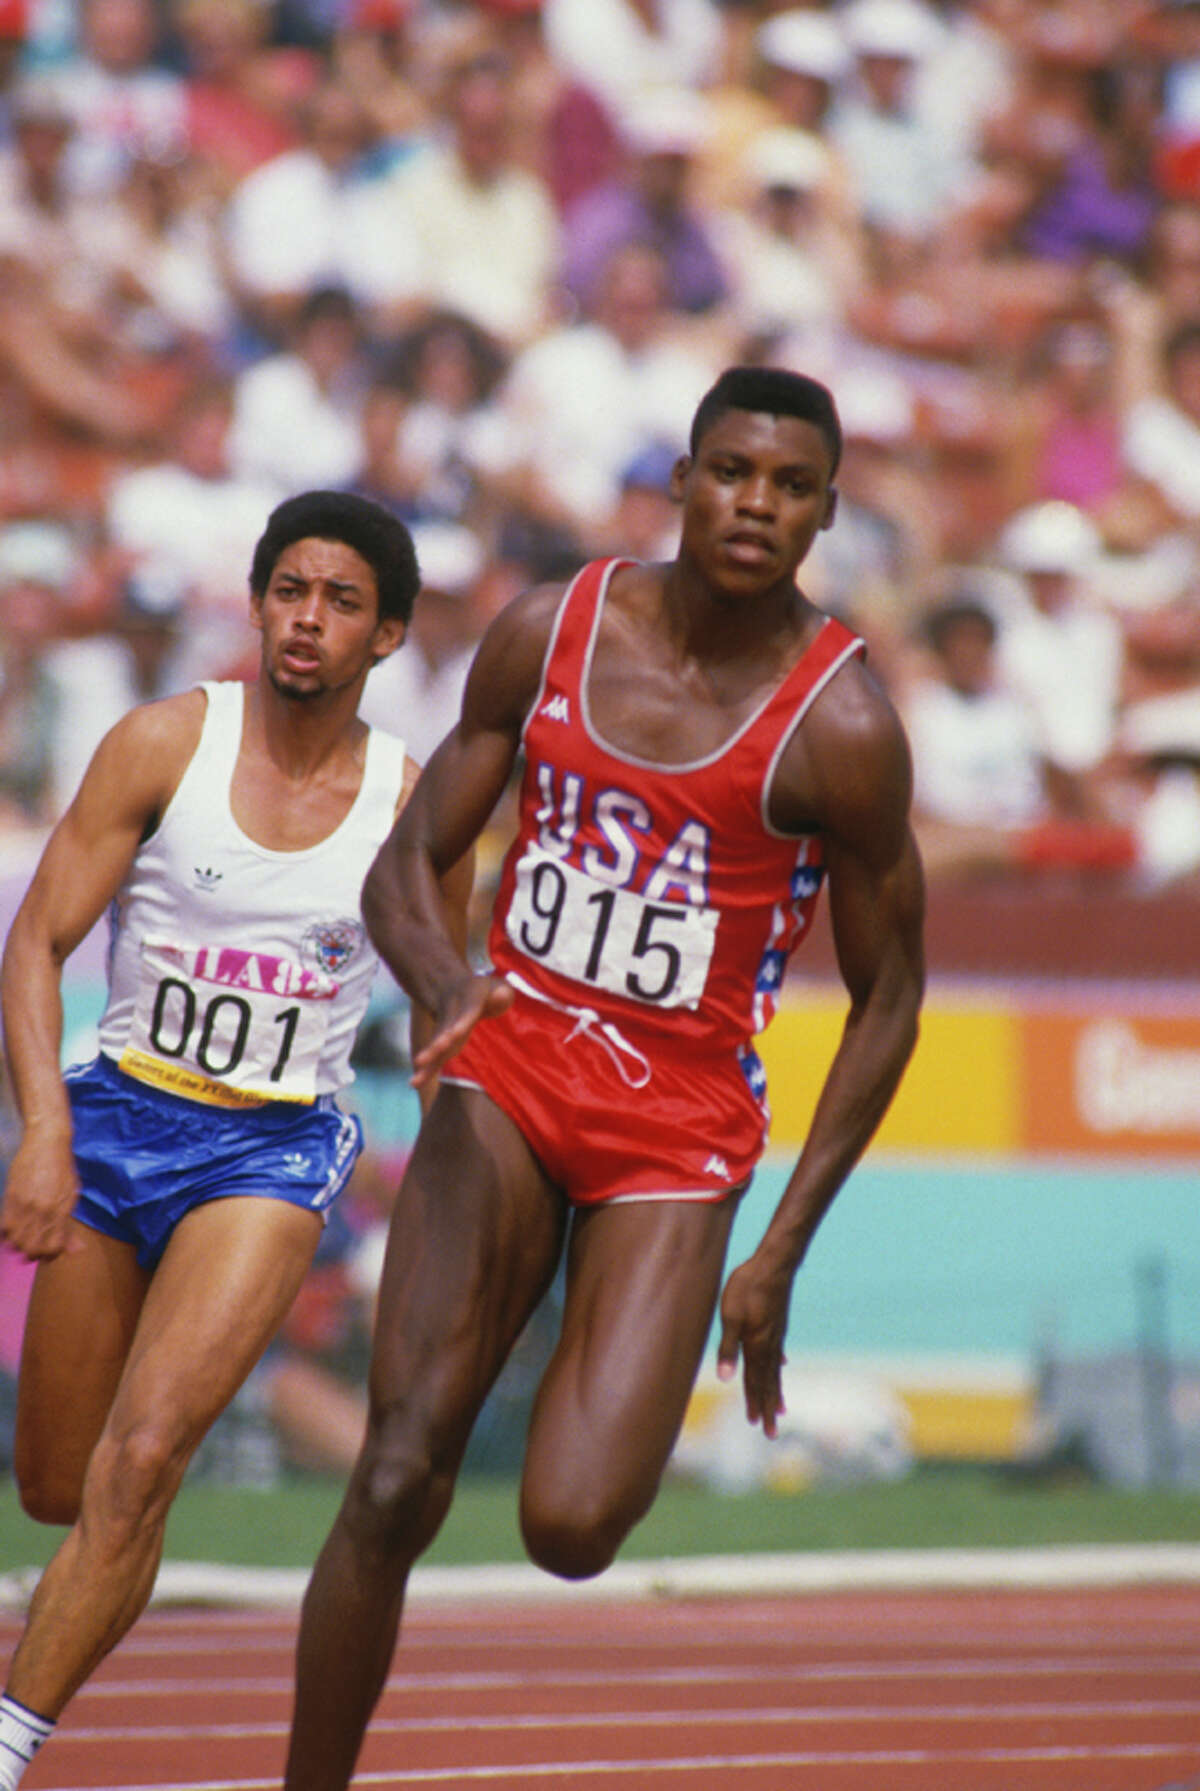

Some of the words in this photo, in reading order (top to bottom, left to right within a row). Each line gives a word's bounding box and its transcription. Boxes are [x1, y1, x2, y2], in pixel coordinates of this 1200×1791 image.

[536, 761, 711, 908] USA
[520, 861, 686, 1001] 915
[150, 976, 300, 1083] 001
